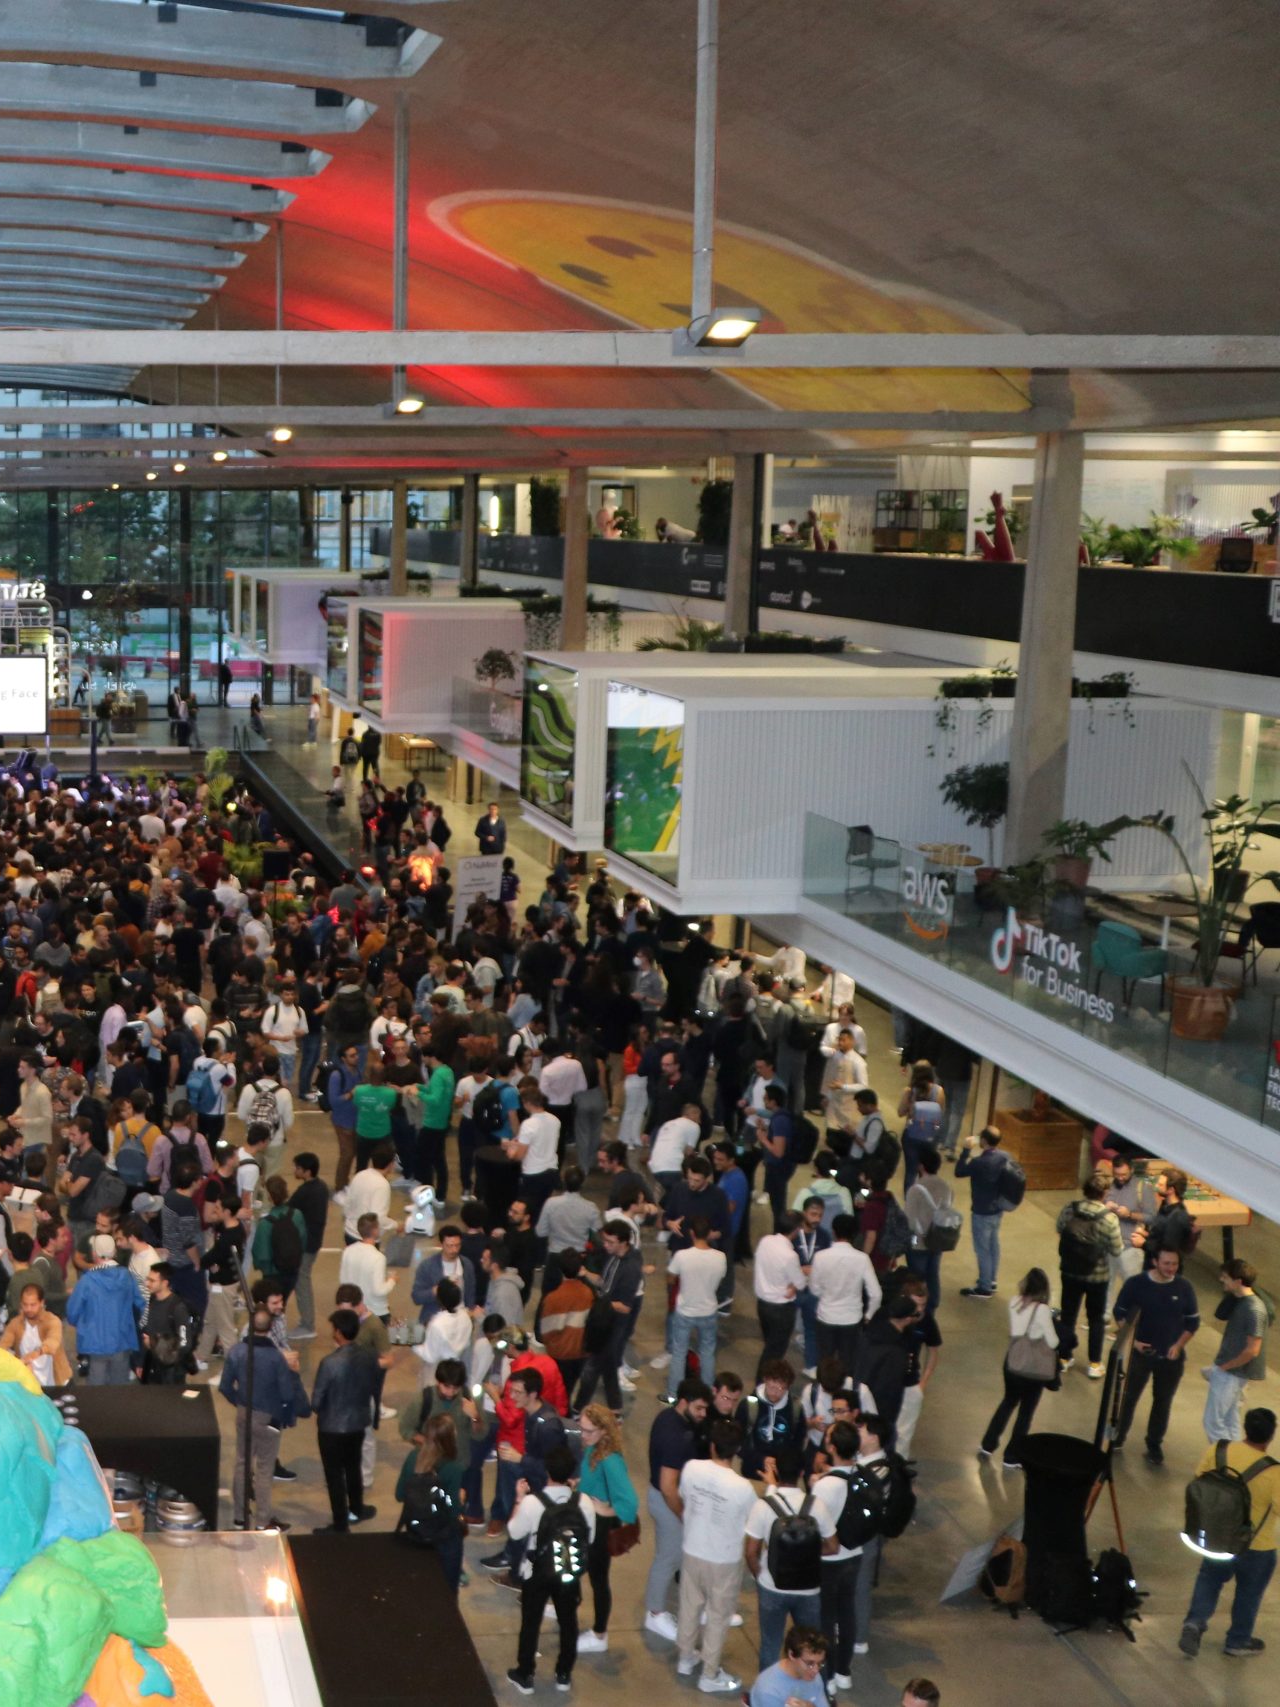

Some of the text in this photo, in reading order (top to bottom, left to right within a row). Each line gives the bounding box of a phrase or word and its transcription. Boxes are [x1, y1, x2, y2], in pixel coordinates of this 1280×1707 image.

[12, 688, 39, 698] Face
[903, 866, 949, 915] aws
[1023, 922, 1081, 973] TikTok
[1022, 955, 1114, 1023] for Business
